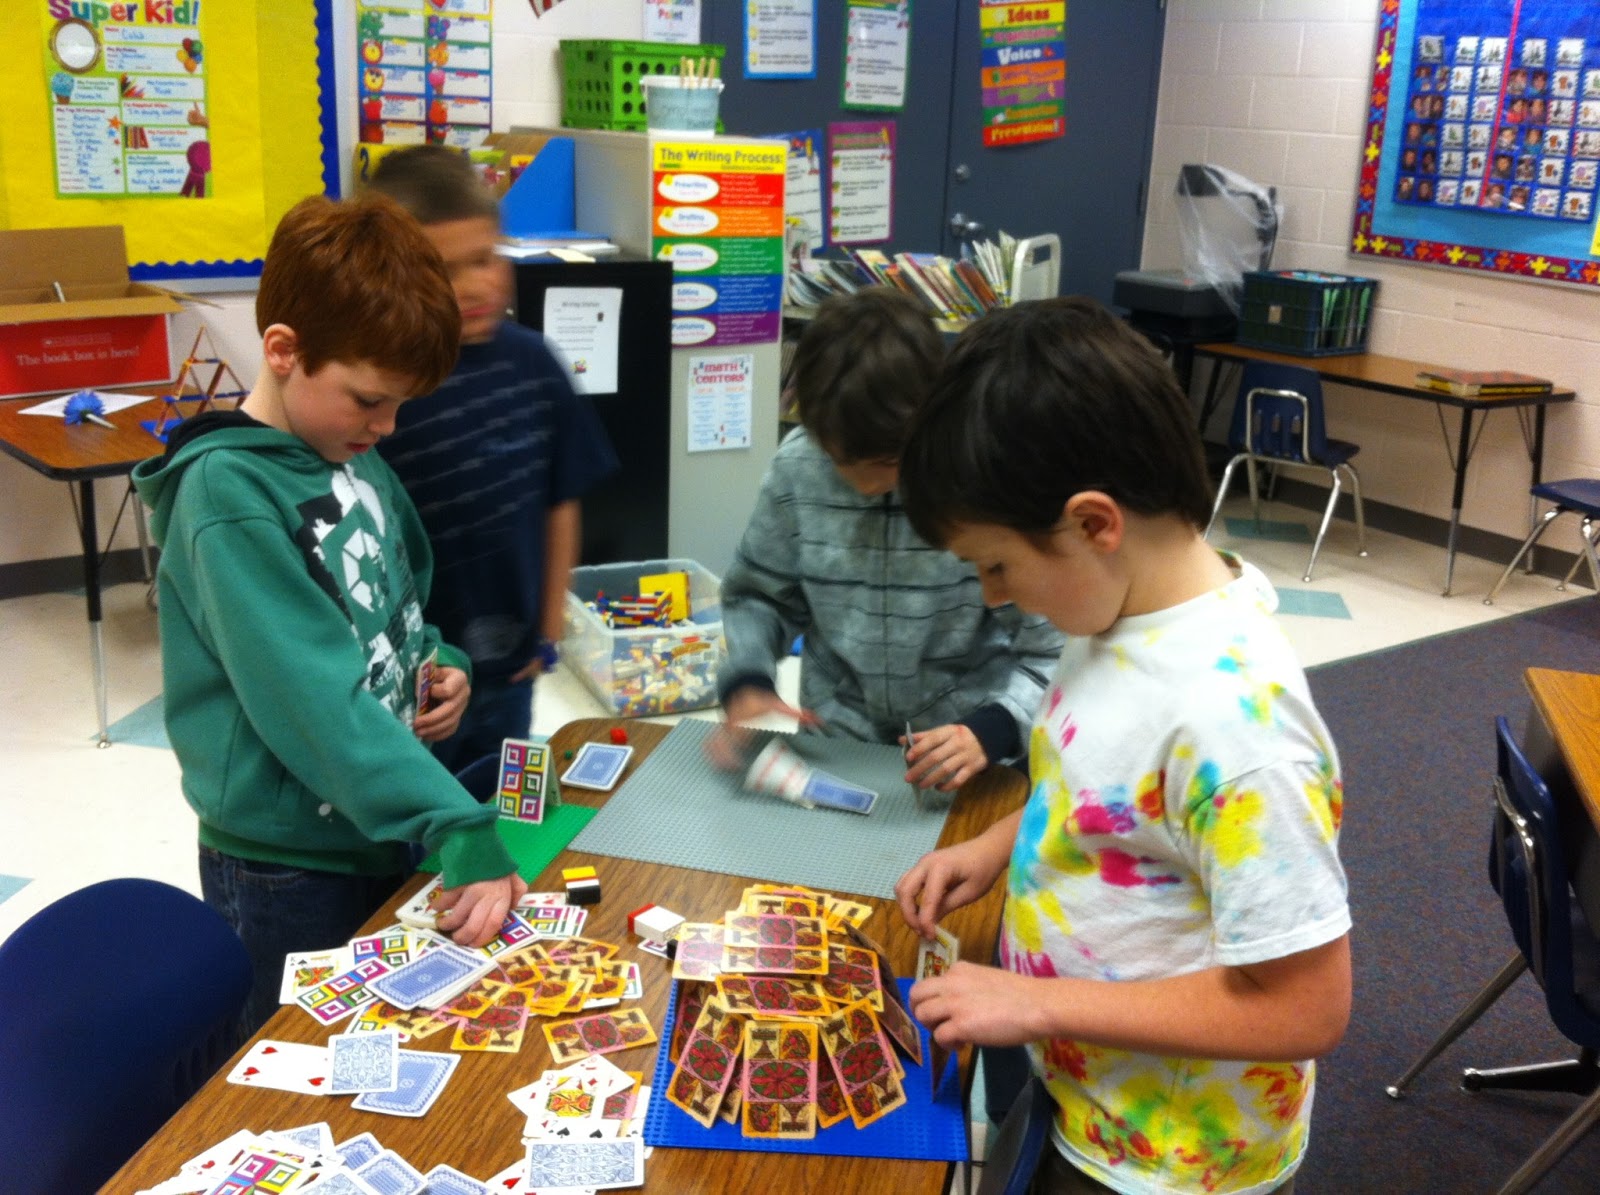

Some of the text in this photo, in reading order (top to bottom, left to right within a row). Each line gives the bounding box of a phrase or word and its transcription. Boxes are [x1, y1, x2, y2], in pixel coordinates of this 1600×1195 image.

[49, 0, 200, 28] Super Kid!
[1008, 8, 1050, 23] Ideas
[997, 46, 1042, 65] Voice
[661, 147, 683, 161] The
[687, 149, 731, 164] Writing
[17, 353, 41, 366] The
[43, 351, 72, 364] book
